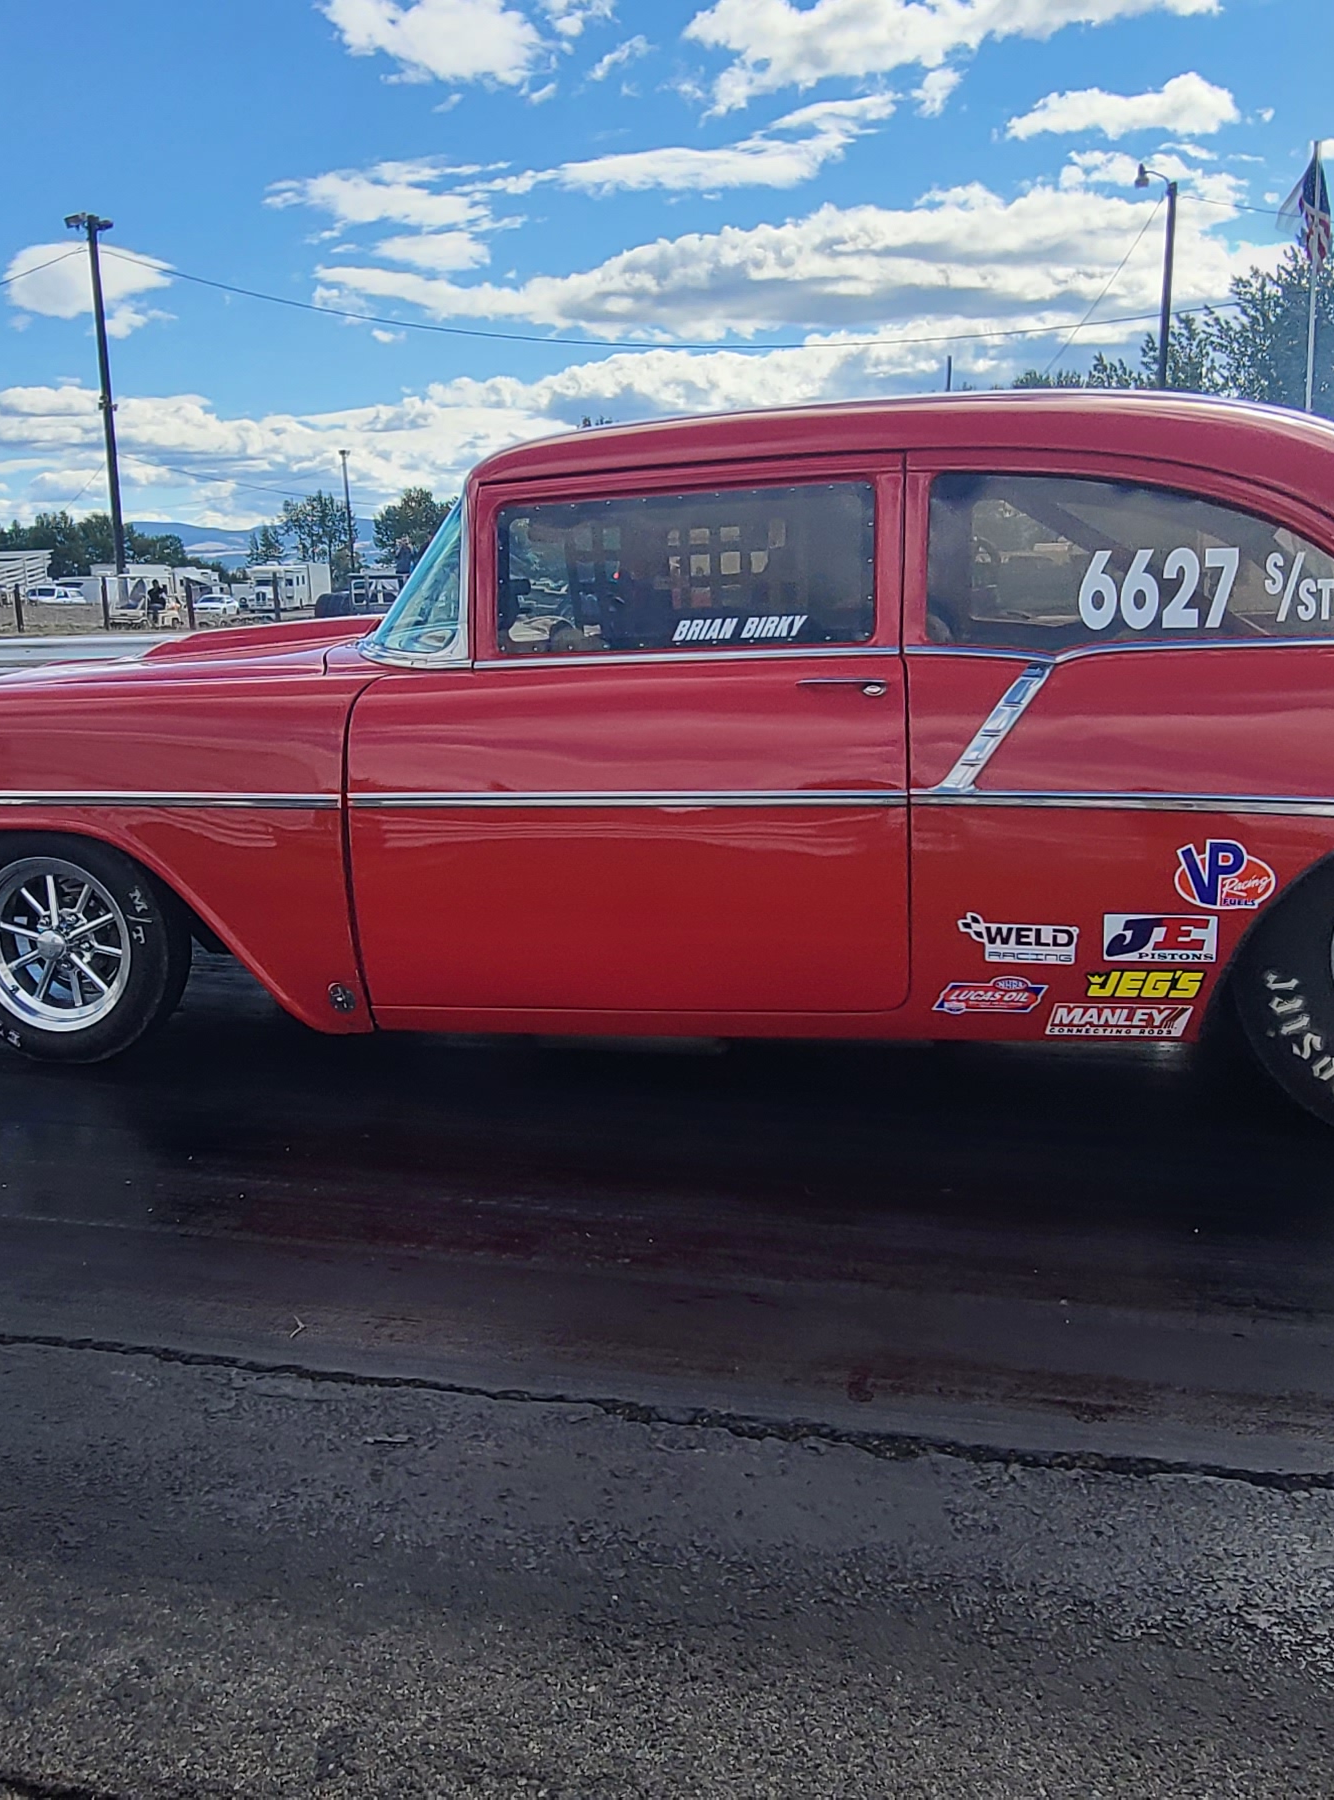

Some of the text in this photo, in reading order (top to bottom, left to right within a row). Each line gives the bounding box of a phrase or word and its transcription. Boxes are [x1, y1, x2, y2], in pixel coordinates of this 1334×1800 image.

[1078, 547, 1334, 630] 6627 S/ST
[672, 615, 808, 641] BRIAN BIRKY
[1178, 840, 1247, 907] VP
[1221, 874, 1272, 899] Racing
[1222, 898, 1256, 906] FUELS
[126, 886, 154, 945] M/T
[985, 925, 1075, 948] WELD
[1105, 917, 1210, 957] JE
[987, 951, 1073, 963] RACING
[1137, 952, 1214, 961] PISTONS
[948, 990, 1029, 1003] LUCAS OIL
[1087, 970, 1205, 999] JEG'S
[1052, 1007, 1171, 1027] MANLEY
[1048, 1027, 1173, 1036] CONNECTING RODS
